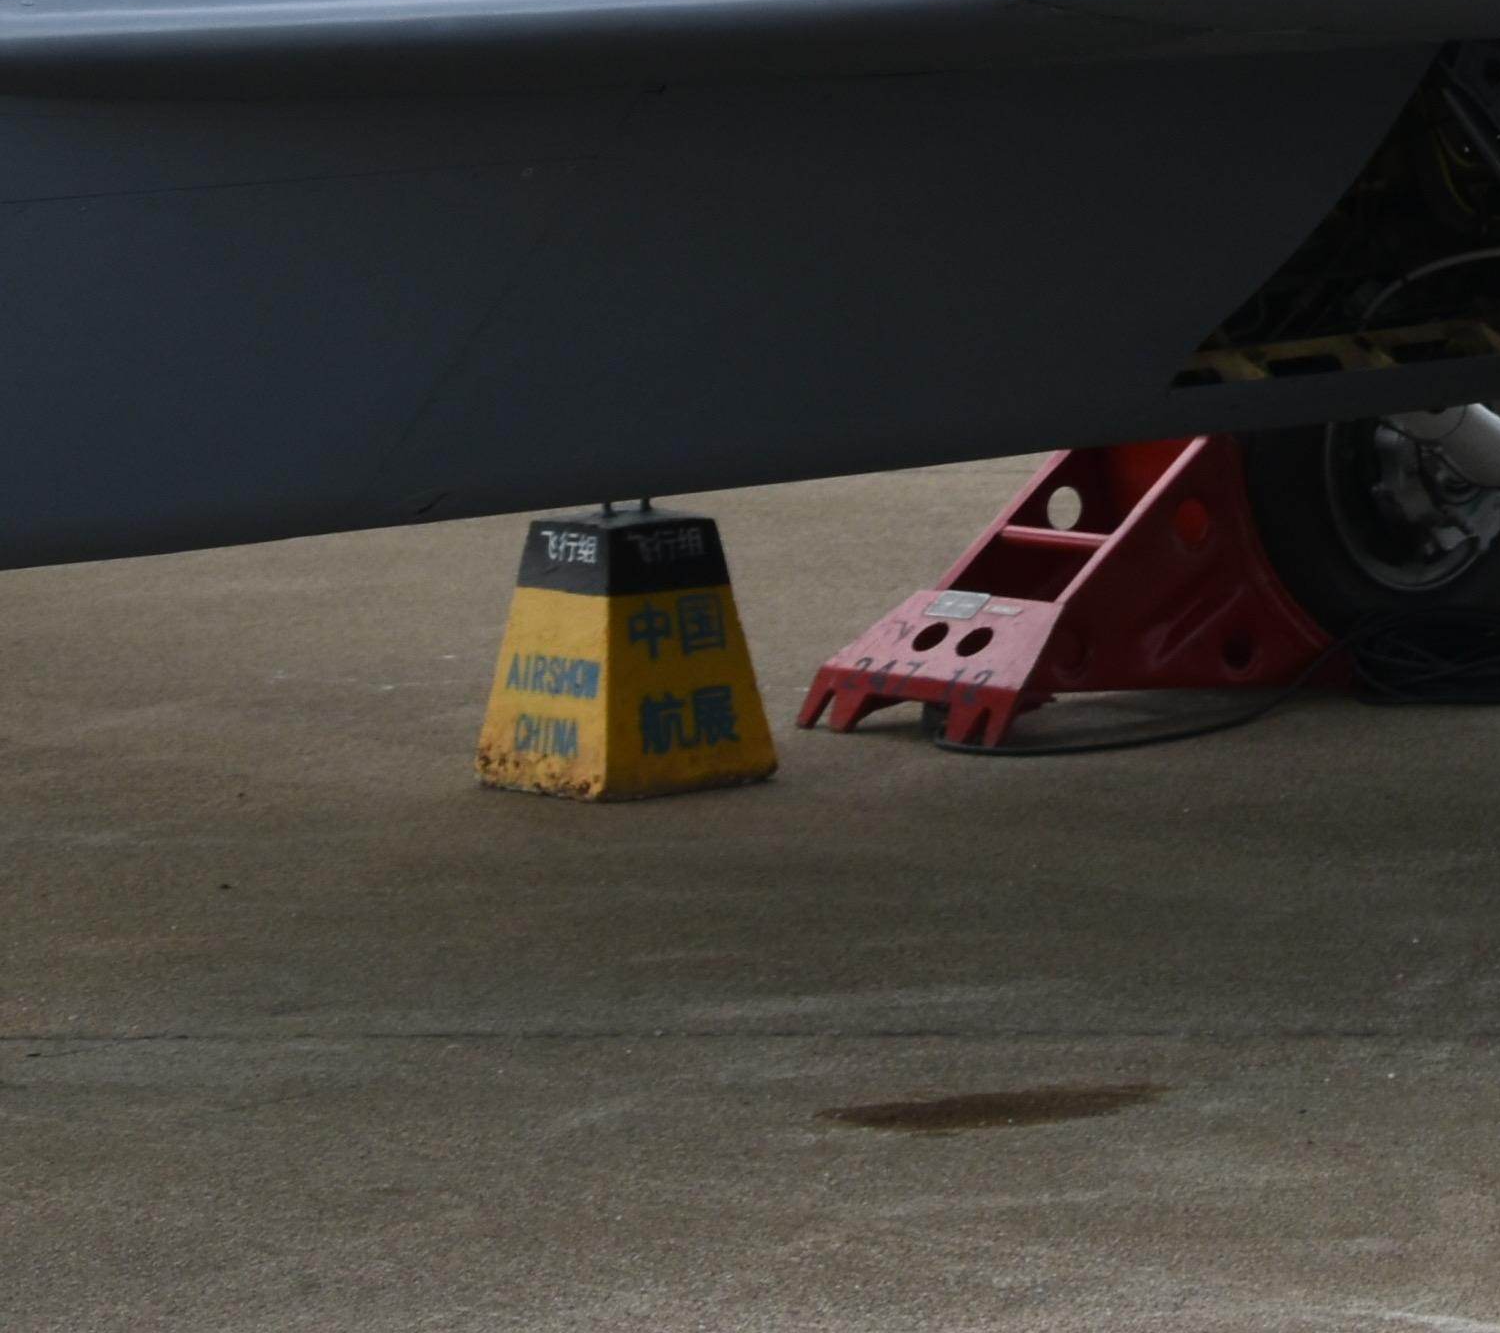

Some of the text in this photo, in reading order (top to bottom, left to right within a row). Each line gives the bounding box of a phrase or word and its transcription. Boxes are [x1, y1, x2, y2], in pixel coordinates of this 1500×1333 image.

[540, 530, 598, 564] 飞行组
[627, 592, 726, 661] 中国
[505, 651, 600, 701] AIRSHOW
[513, 711, 580, 758] CHINA
[638, 685, 742, 756] 航展
